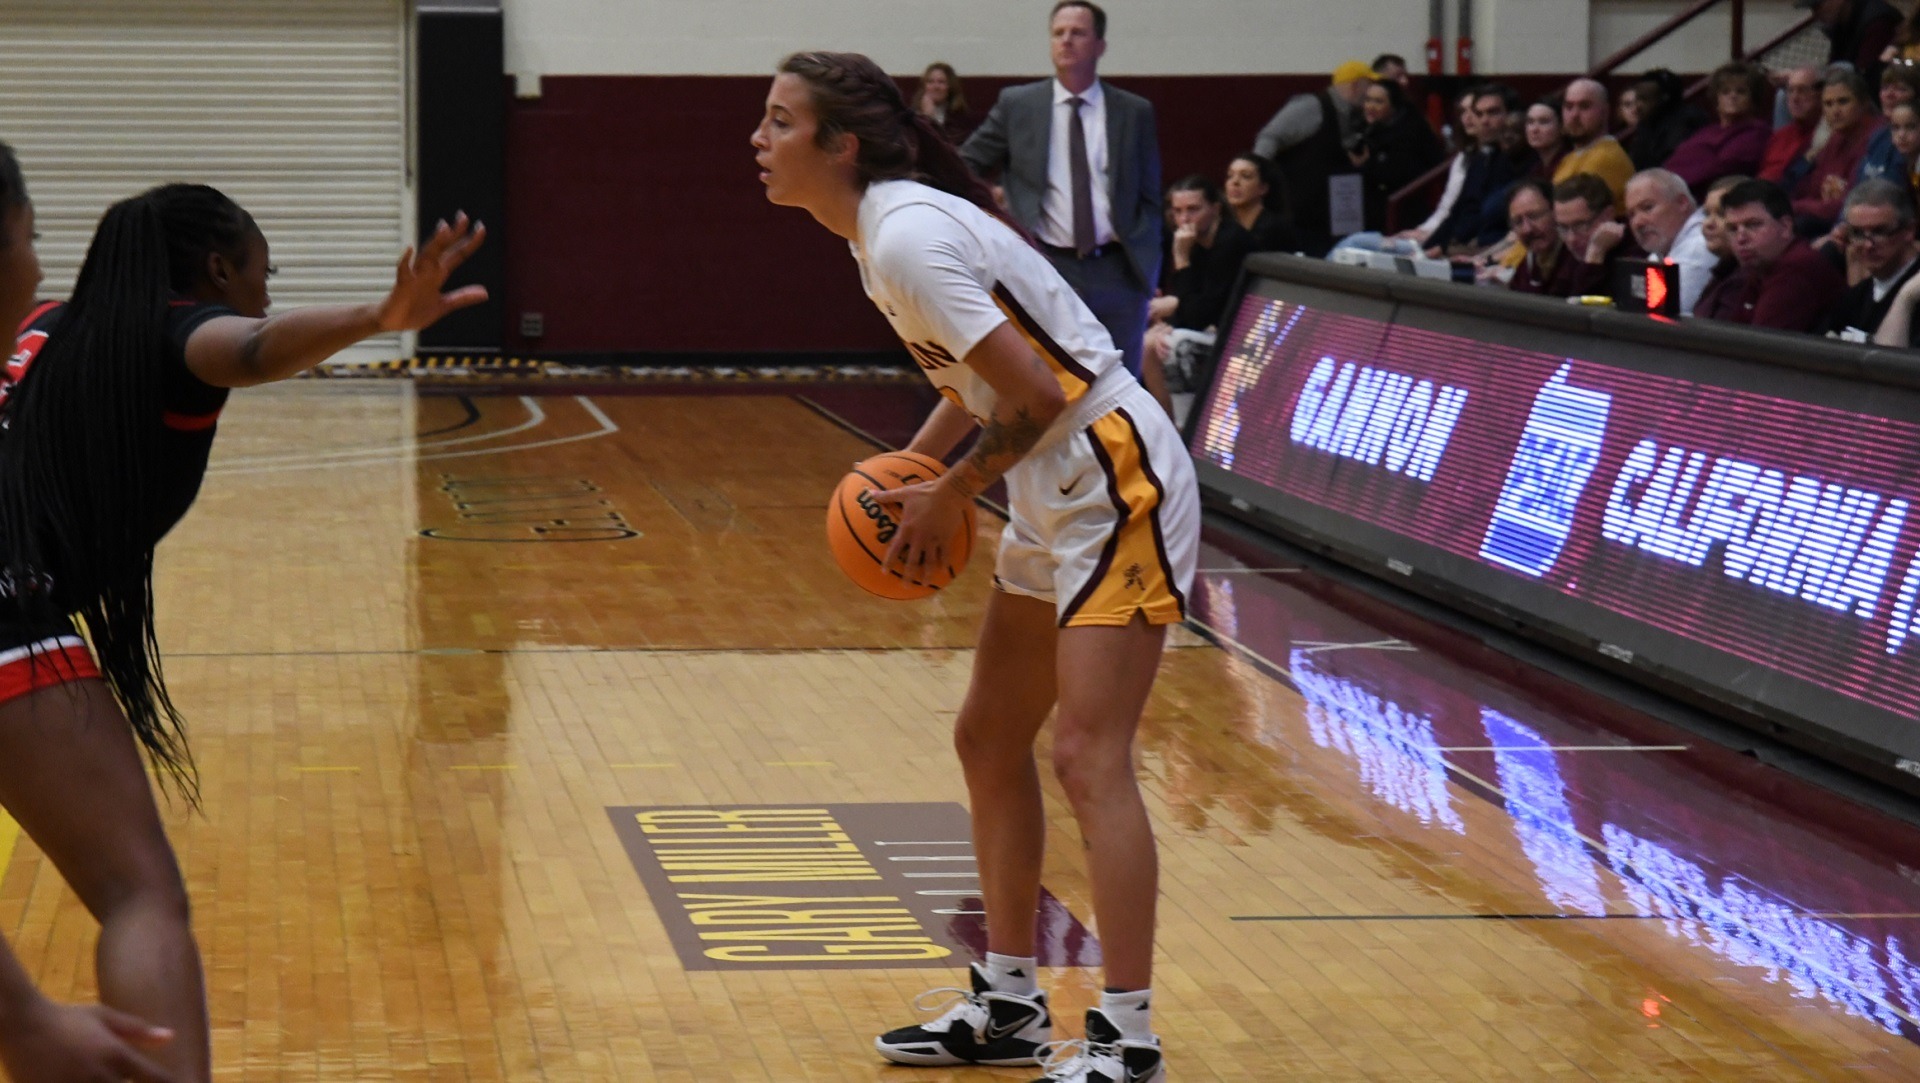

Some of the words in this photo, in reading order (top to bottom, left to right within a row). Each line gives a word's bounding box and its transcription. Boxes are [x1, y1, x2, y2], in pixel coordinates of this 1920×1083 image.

[1290, 356, 1469, 482] GANNON
[1602, 439, 1909, 619] CALIFORNIA
[635, 808, 883, 883] MILLER
[677, 893, 953, 961] GARY
